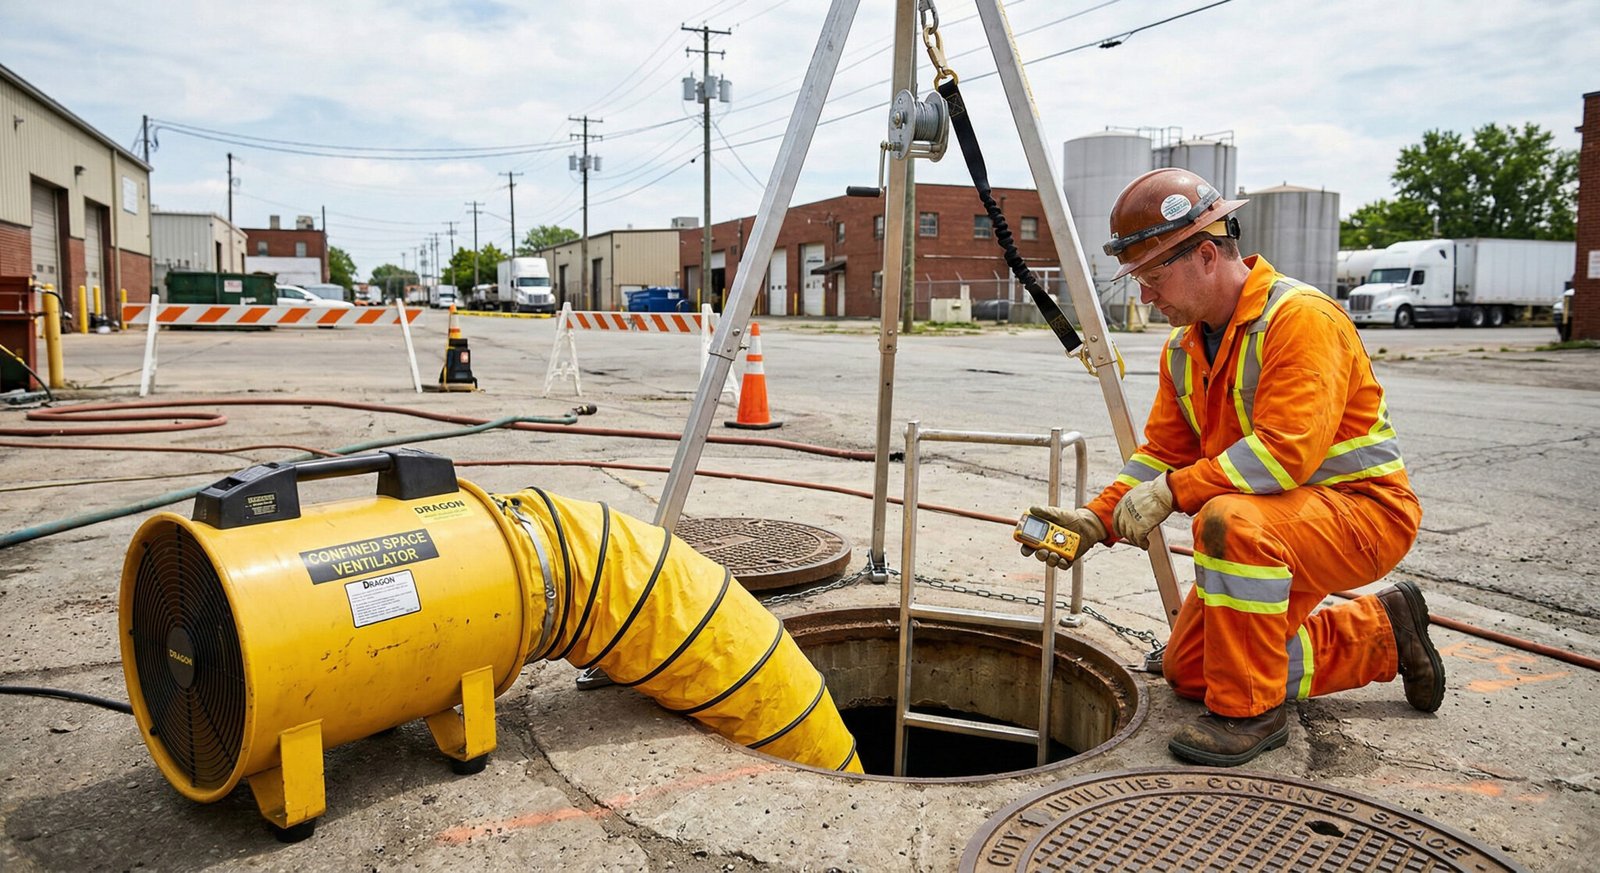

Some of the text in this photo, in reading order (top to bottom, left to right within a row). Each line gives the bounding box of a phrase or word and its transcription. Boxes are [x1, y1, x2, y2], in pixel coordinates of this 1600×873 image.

[414, 500, 465, 514] DRAGON
[308, 532, 427, 565] CONFINED SPACE
[332, 548, 419, 576] VENTILATOR
[987, 830, 1027, 867] CITY
[1049, 777, 1174, 813] UTILITIES
[1207, 777, 1358, 813] CONFINED
[1370, 811, 1472, 859] SPACE
